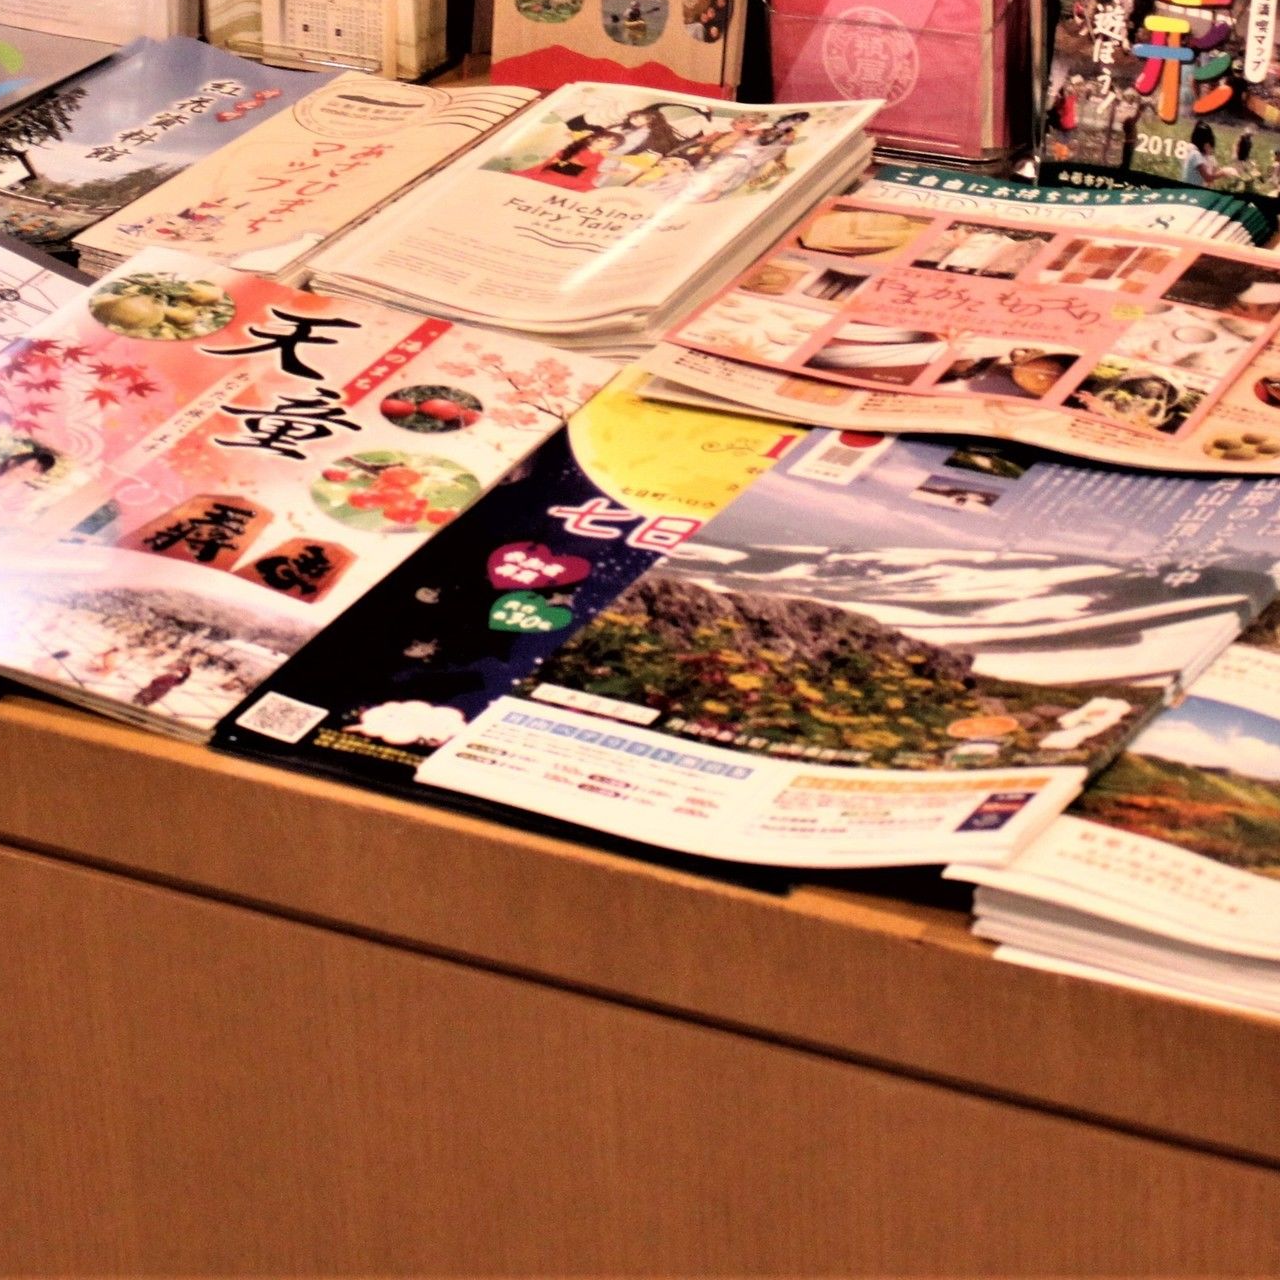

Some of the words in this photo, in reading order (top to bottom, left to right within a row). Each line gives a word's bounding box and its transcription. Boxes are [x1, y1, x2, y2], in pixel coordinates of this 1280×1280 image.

[1136, 133, 1189, 159] 2018
[502, 195, 566, 224] Fairy
[573, 211, 624, 234] Tale
[200, 307, 363, 461] 天童
